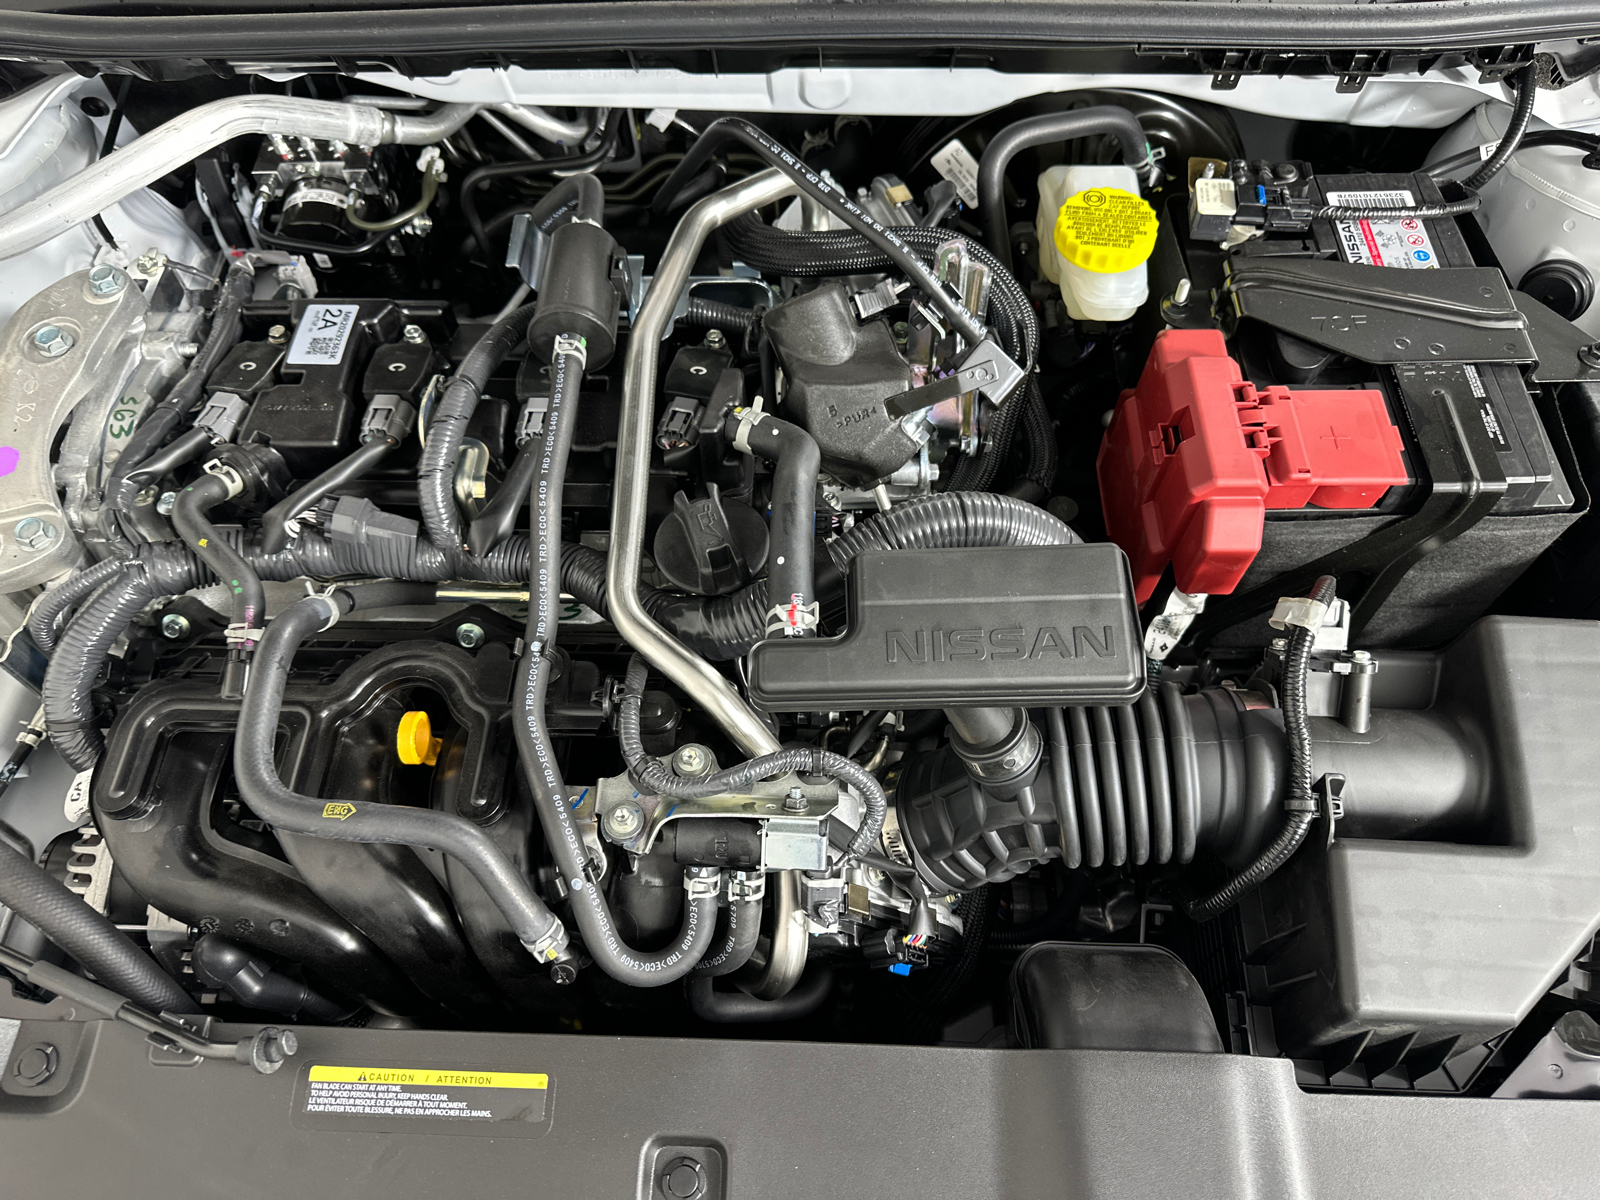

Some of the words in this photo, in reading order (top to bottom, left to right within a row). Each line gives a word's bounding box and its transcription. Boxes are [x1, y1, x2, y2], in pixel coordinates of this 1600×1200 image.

[318, 308, 342, 330] 2A
[239, 361, 257, 370] C
[388, 362, 406, 372] C
[690, 366, 708, 374] C
[541, 411, 559, 474] TRD>ECO<5409
[538, 480, 548, 562] TRD>ECO<5409
[536, 568, 548, 638] TRD>ECO<5409
[886, 626, 1116, 663] NISSAN
[527, 716, 557, 788] TRD>ECO<5409
[682, 900, 698, 950] >ECO<5409
[369, 1073, 414, 1082] CAUTION
[436, 1076, 492, 1084] ATTENTION
